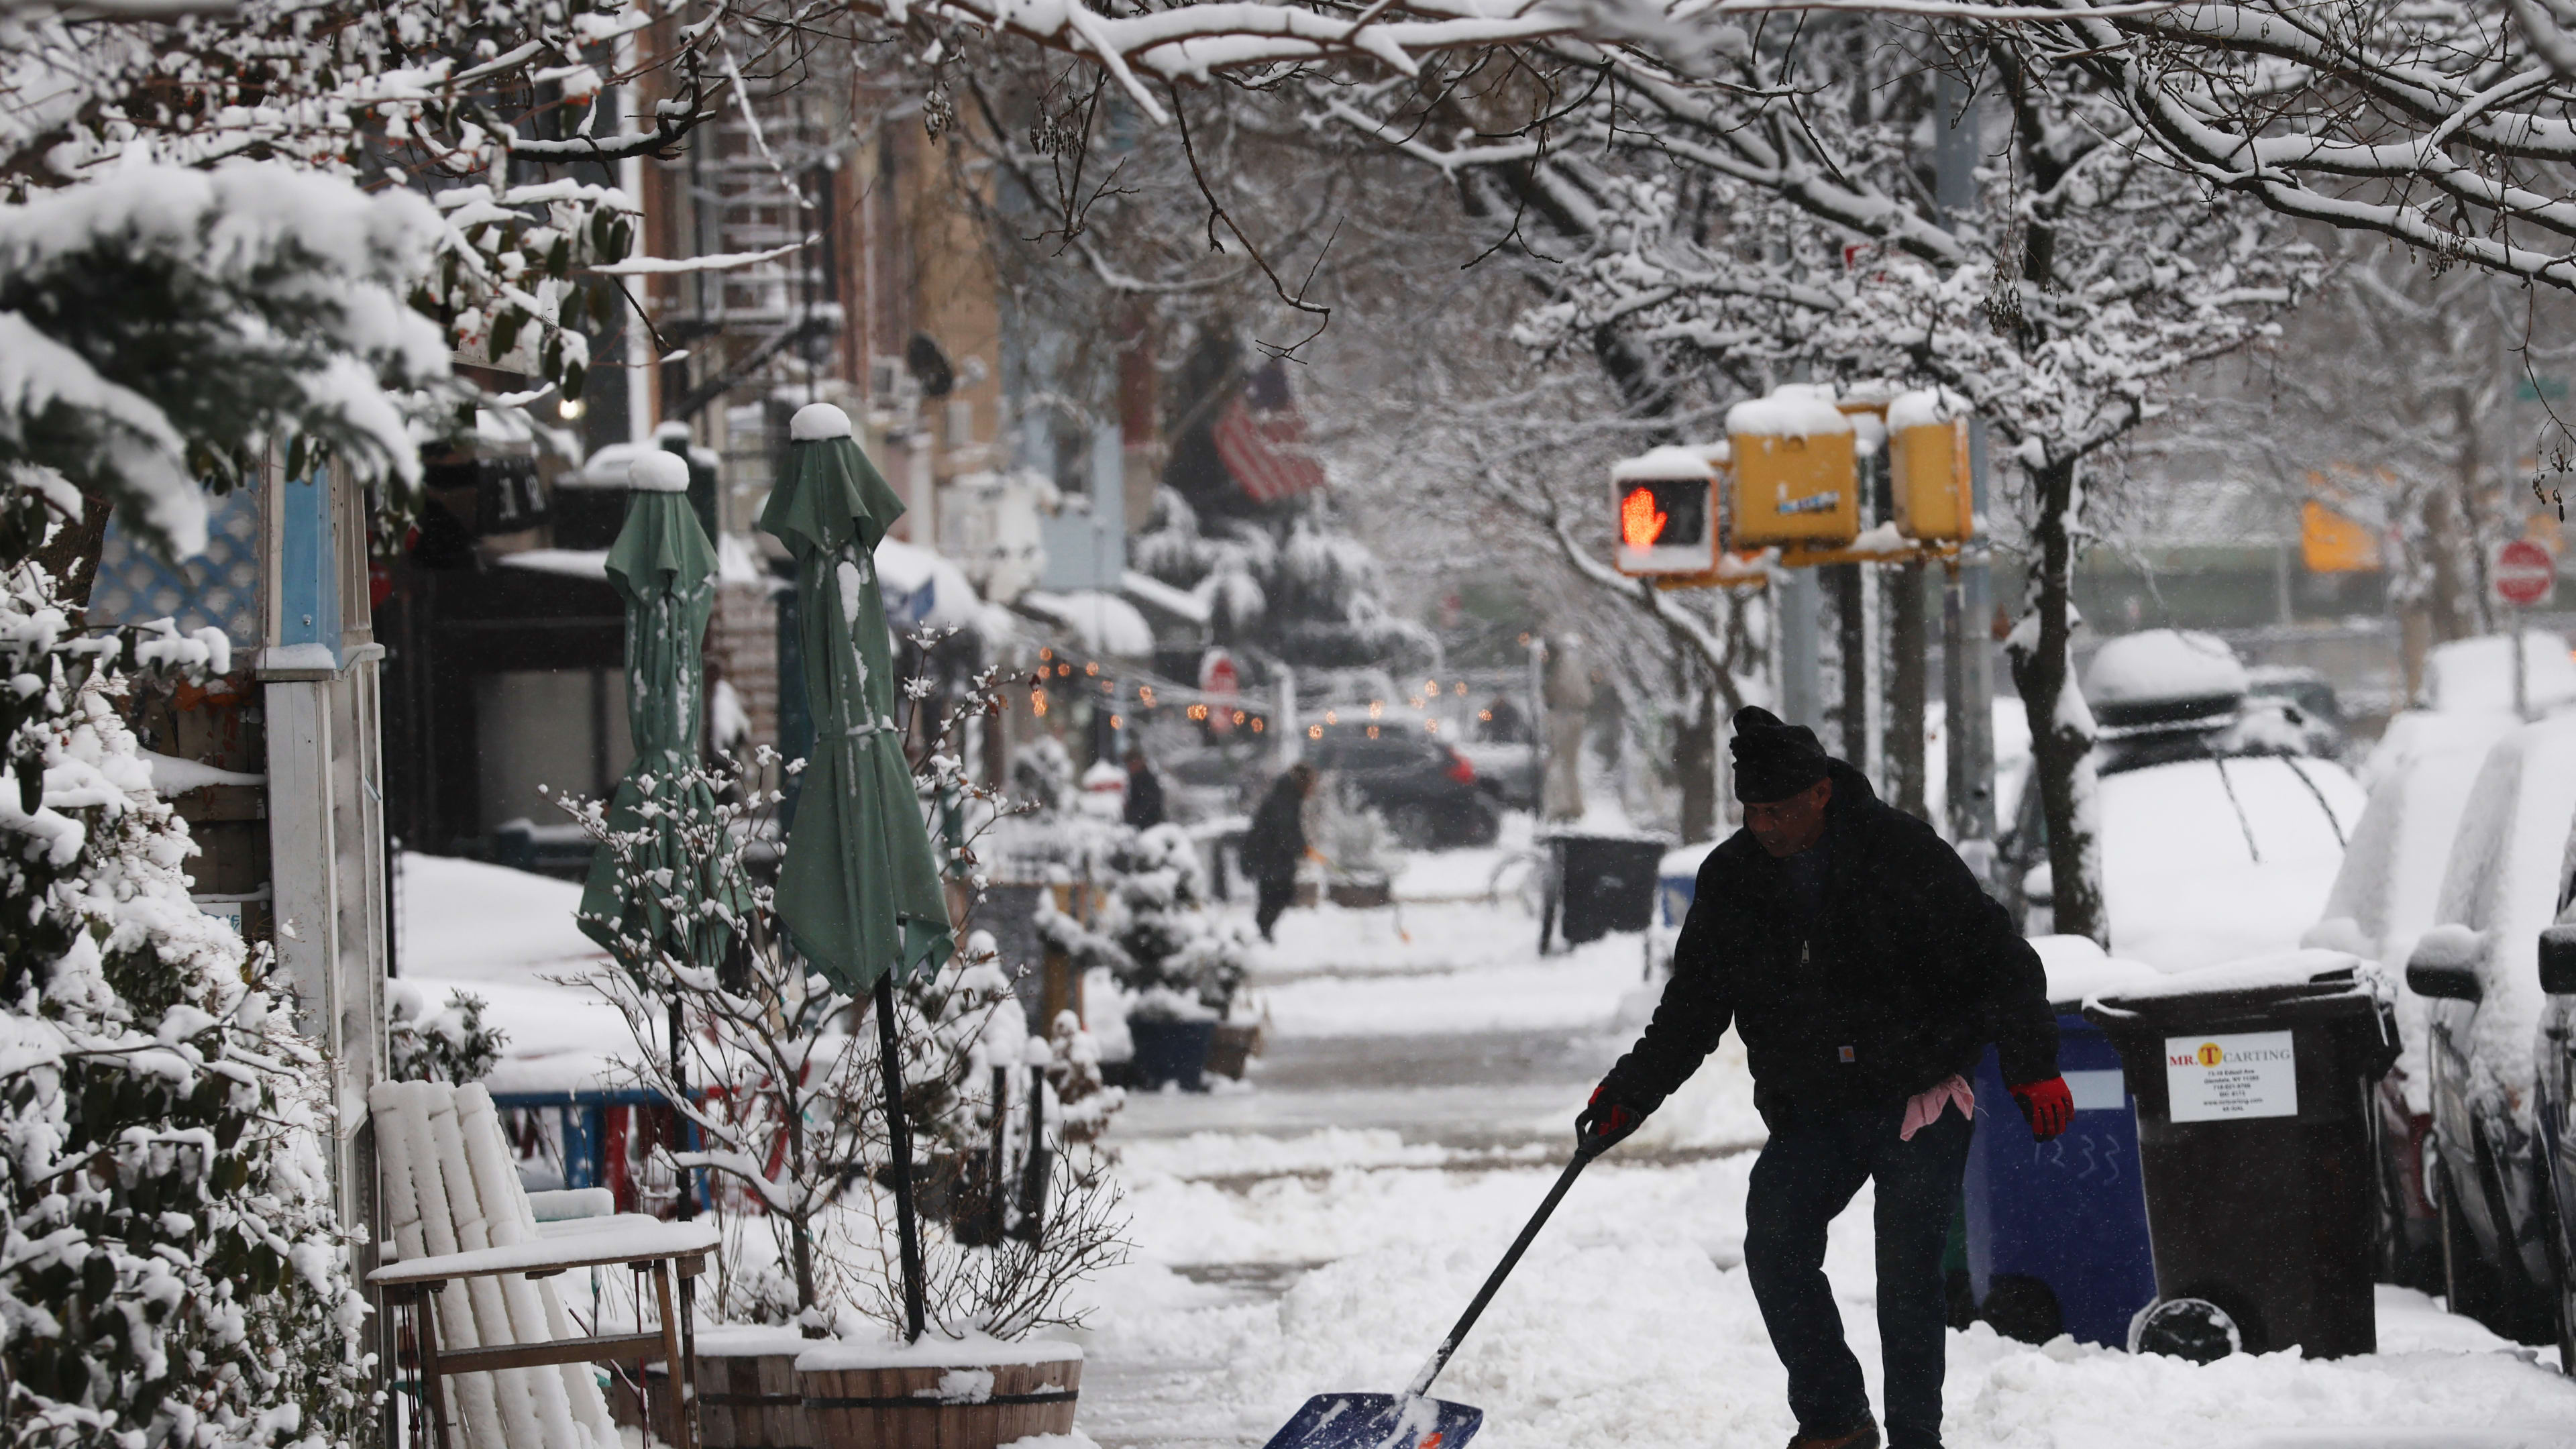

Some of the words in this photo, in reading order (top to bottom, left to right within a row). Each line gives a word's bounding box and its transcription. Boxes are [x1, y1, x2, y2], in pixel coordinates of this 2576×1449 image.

[2169, 1055, 2198, 1066] MR.
[2201, 1046, 2218, 1065] T
[2223, 1049, 2290, 1063] CARTING
